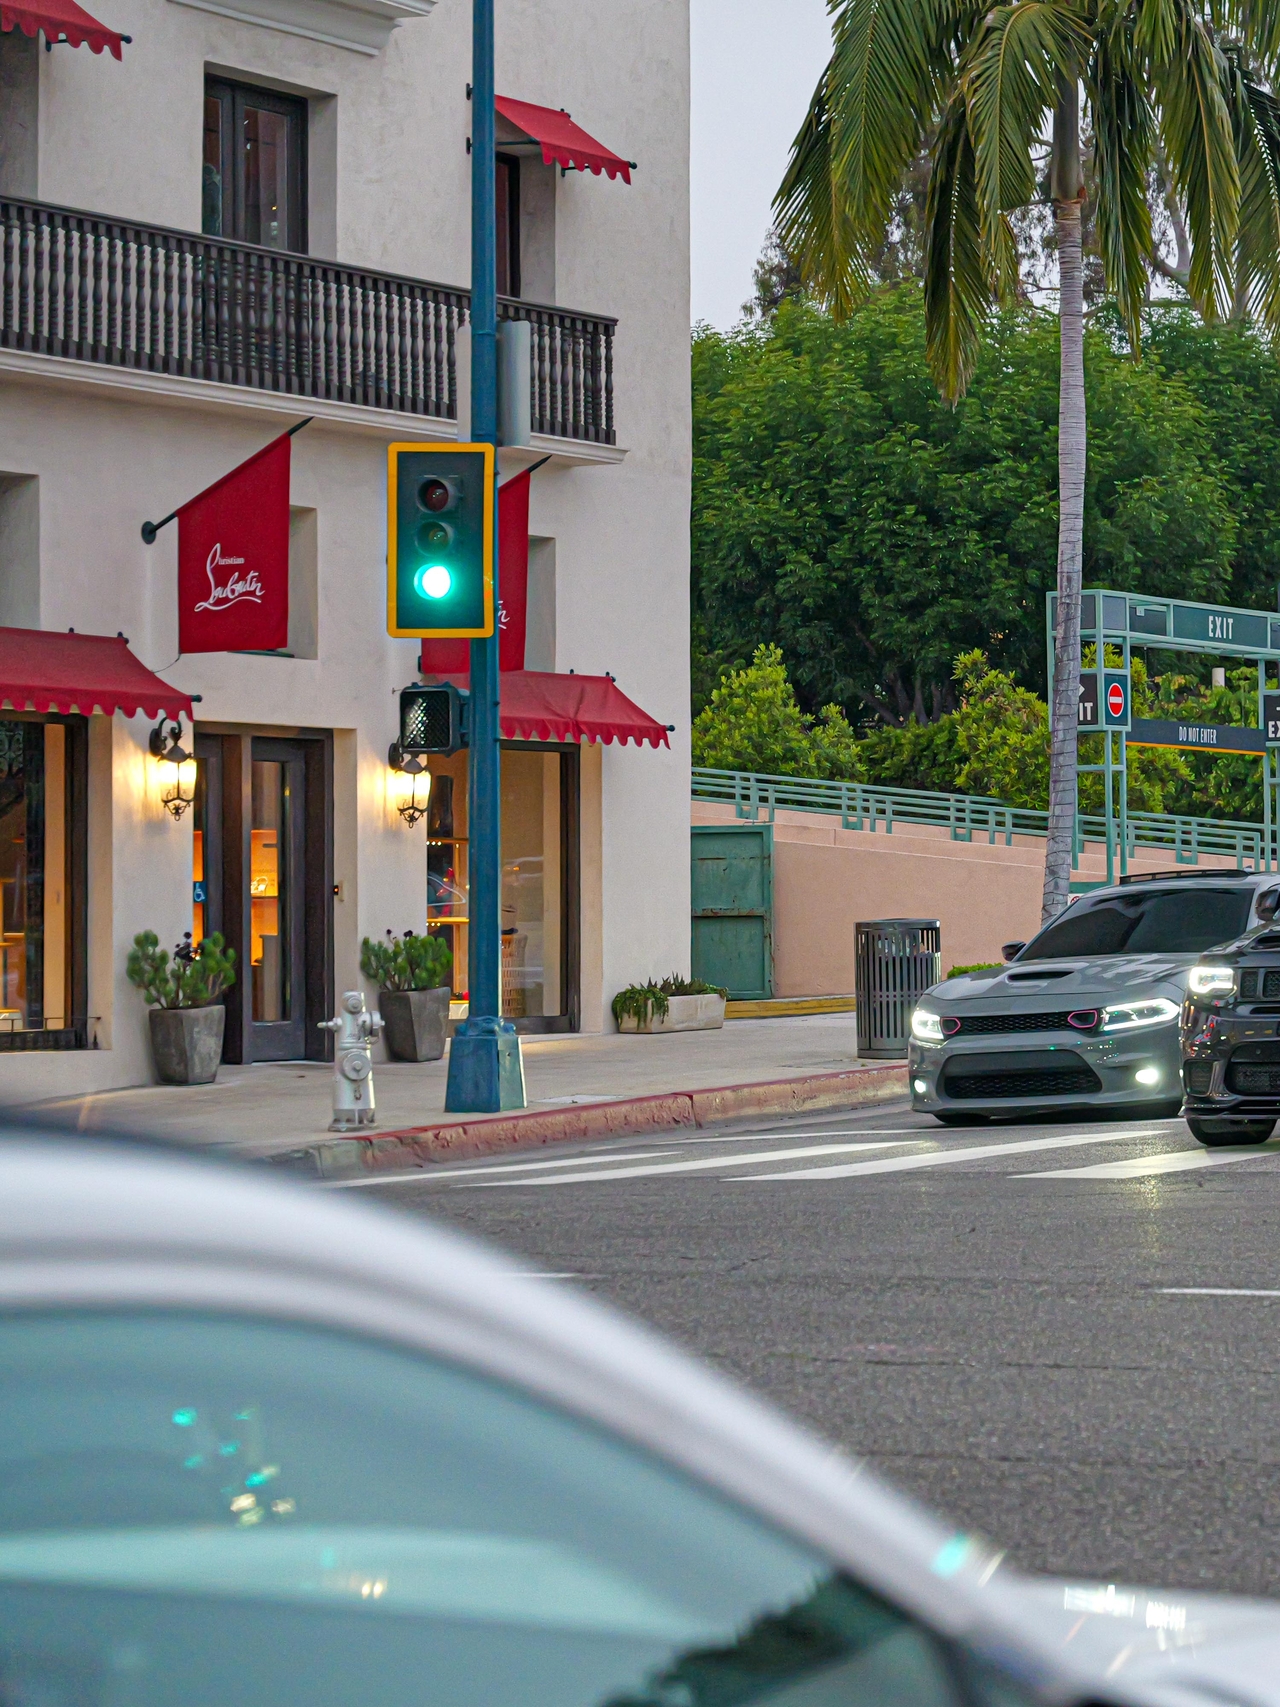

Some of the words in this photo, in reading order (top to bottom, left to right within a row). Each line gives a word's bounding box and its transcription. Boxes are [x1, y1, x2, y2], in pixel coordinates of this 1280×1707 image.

[1208, 615, 1233, 639] EXIT
[1079, 702, 1094, 721] IT
[1178, 726, 1187, 741] DO
[1188, 727, 1199, 743] NOT
[1200, 728, 1217, 744] ENTER
